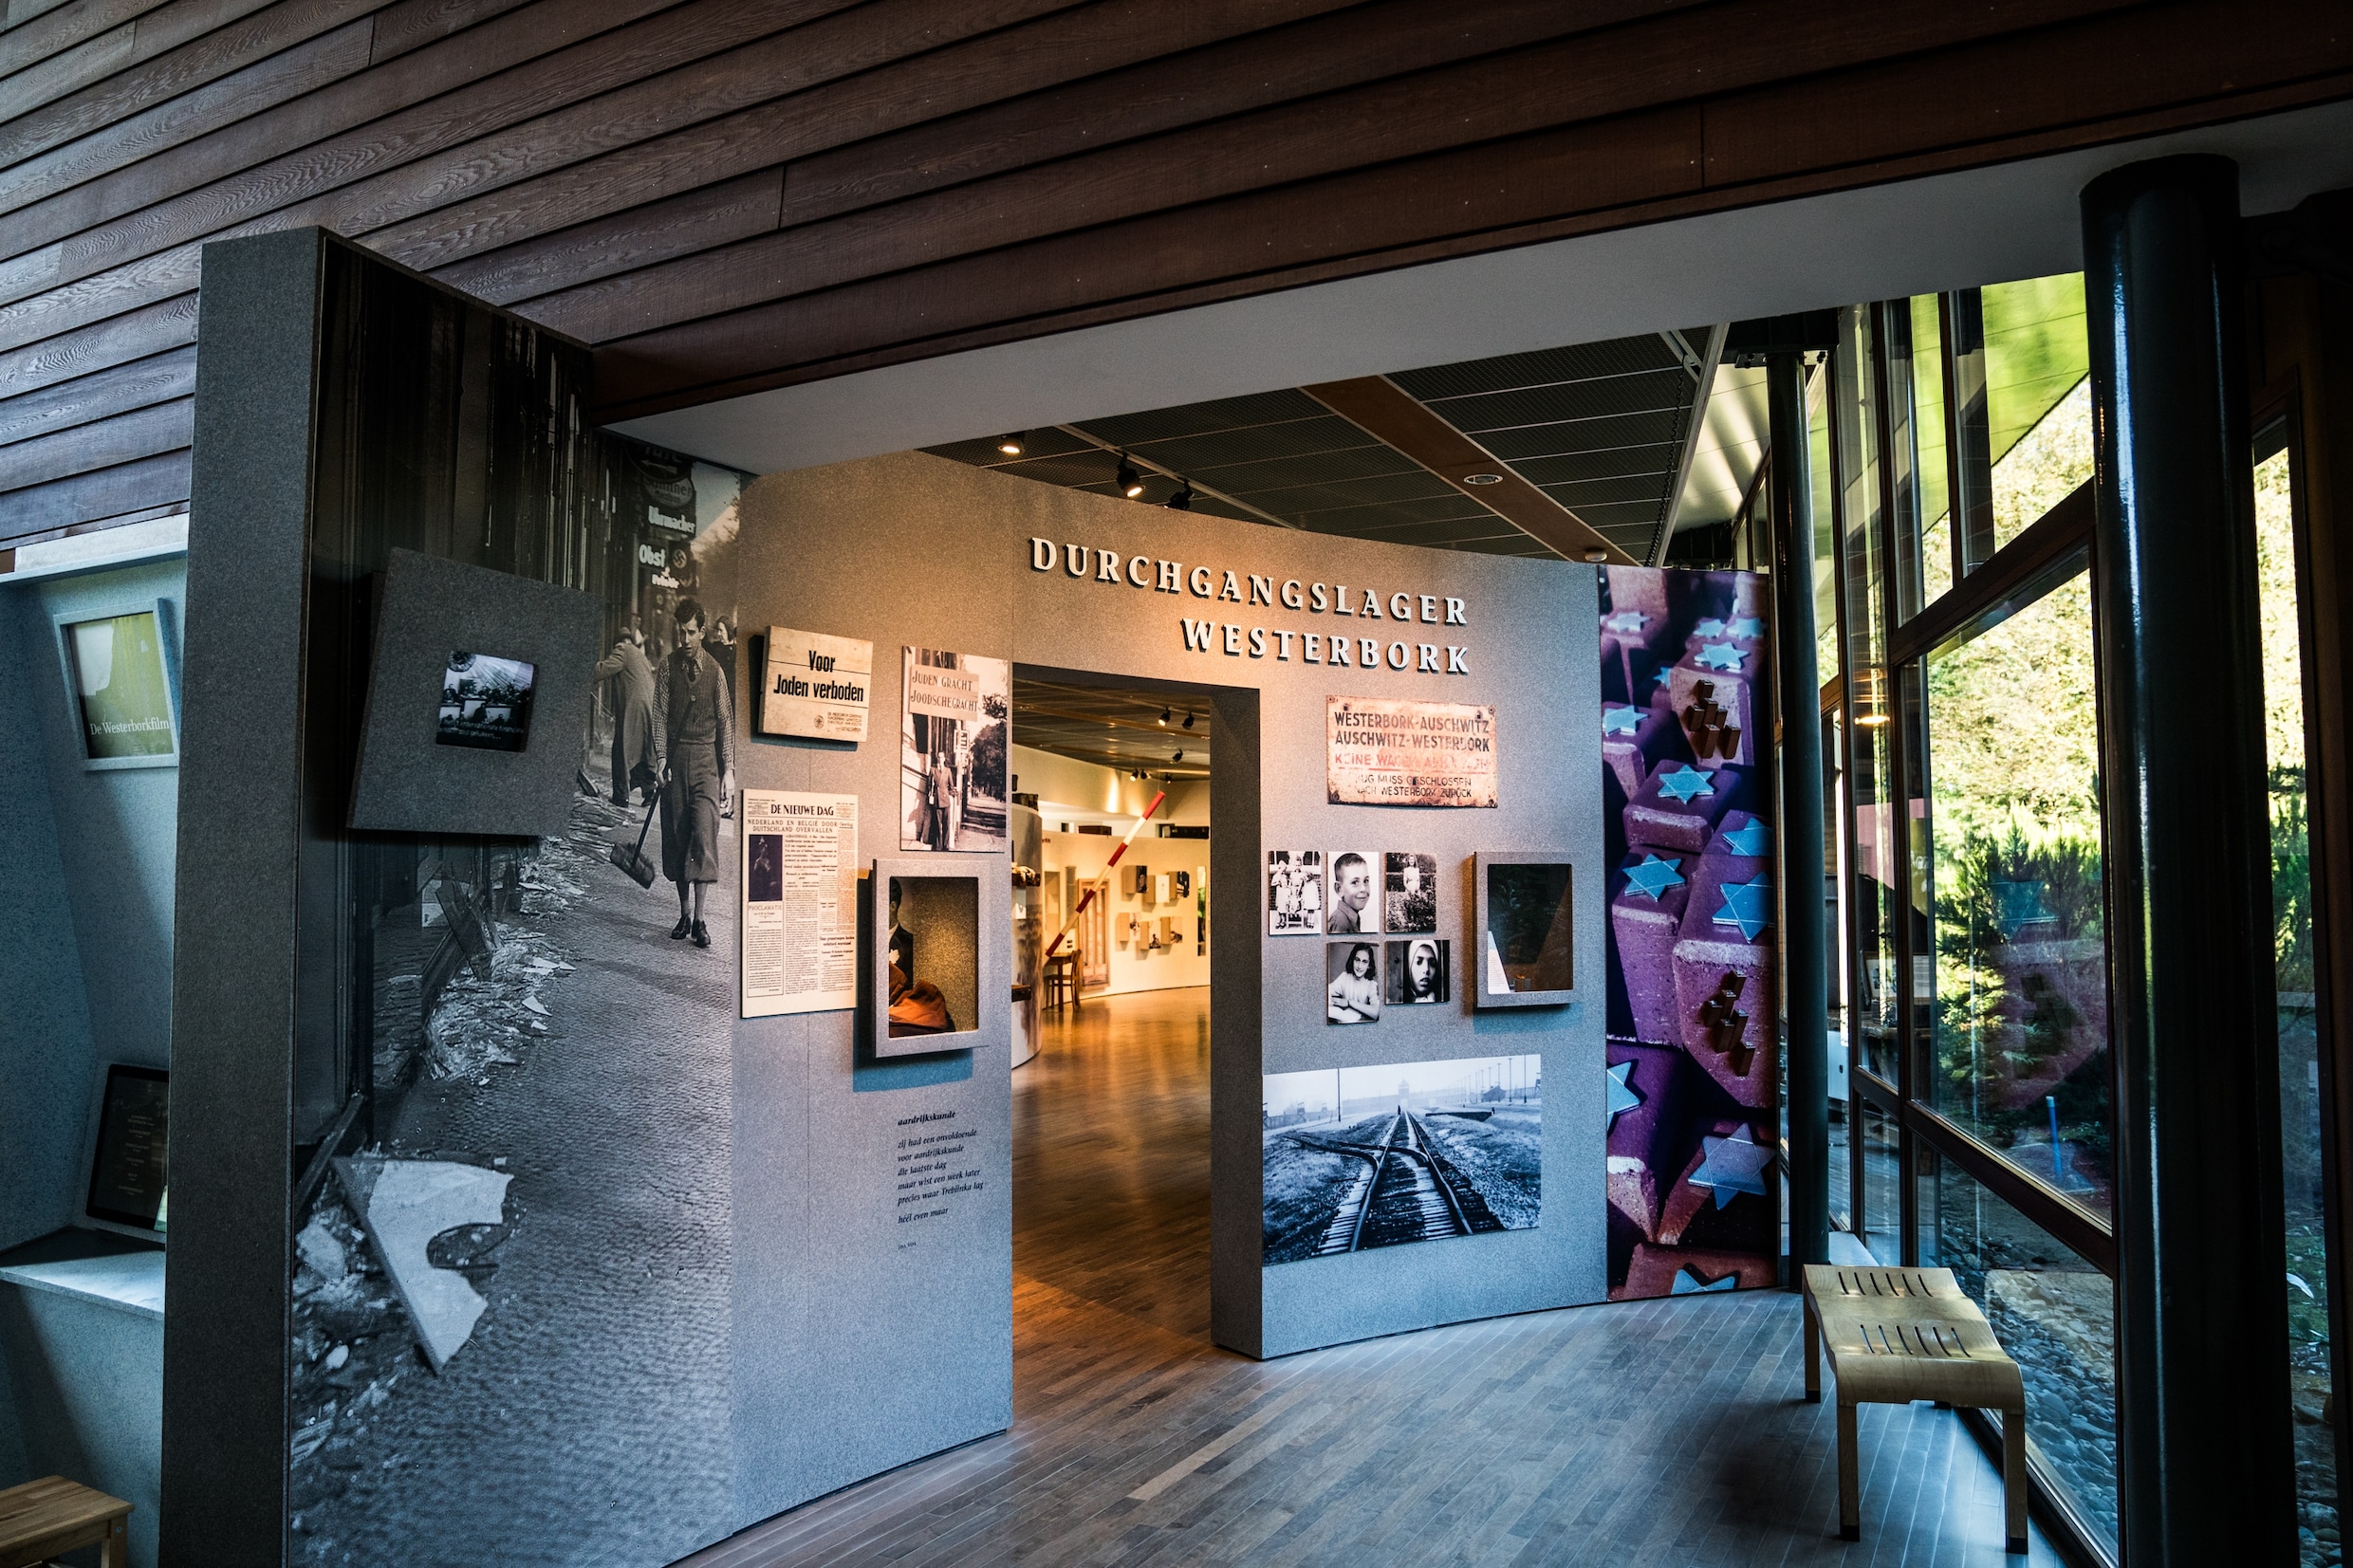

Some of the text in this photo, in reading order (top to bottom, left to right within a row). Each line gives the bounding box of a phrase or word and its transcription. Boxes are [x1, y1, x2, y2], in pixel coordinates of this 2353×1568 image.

[639, 544, 666, 567] Obst
[1030, 536, 1469, 626] DURCHGANGSLAGER
[1181, 617, 1470, 674] WESTERBORK
[808, 650, 836, 673] Voor
[773, 673, 864, 702] Joden verboden
[912, 671, 973, 692] JUDEN GRACHT
[89, 716, 170, 736] De Westerborkfilm
[1335, 711, 1490, 734] WESTERBORK-AUSCHWITZ
[770, 803, 781, 815] DE
[783, 804, 816, 816] NIEUWE
[817, 805, 834, 816] DAG
[898, 1110, 956, 1125] aardrijkskunde
[898, 1139, 907, 1150] zij
[908, 1136, 921, 1147] had
[936, 1129, 977, 1142] onvoldoende
[914, 1144, 964, 1159] aardrijkskunde
[898, 1161, 947, 1176] die laatste dag
[898, 1181, 917, 1190] maar
[917, 1176, 933, 1187] wist
[947, 1171, 963, 1181] week
[965, 1169, 980, 1177] later
[898, 1181, 984, 1207] precies waar Treblinka lag
[913, 1212, 929, 1221] even
[930, 1208, 949, 1217] maar
